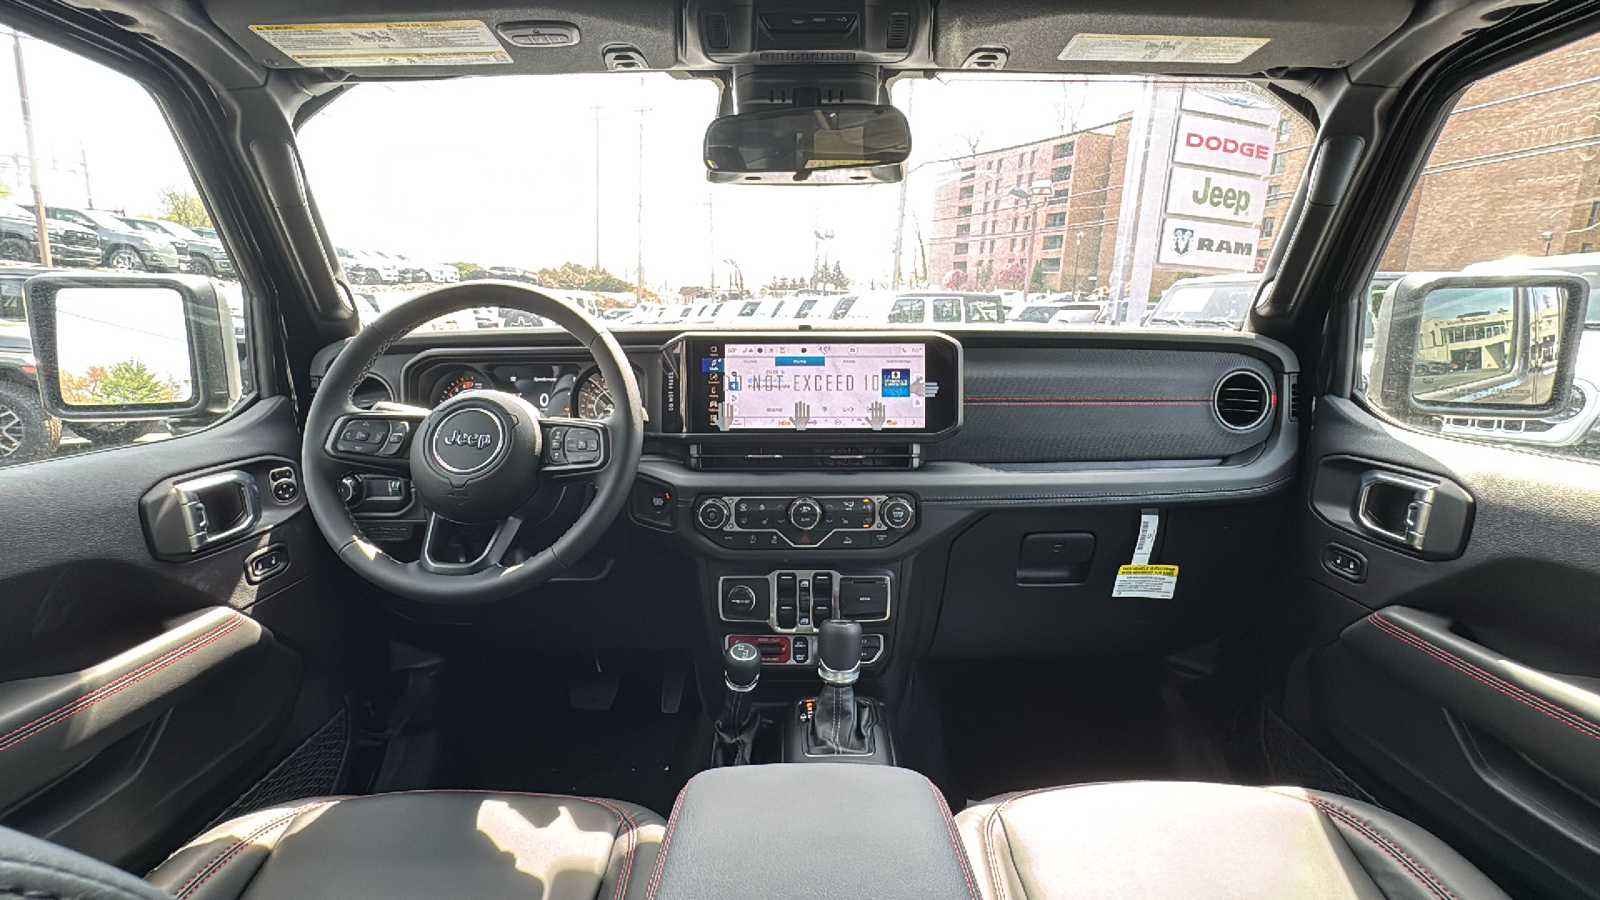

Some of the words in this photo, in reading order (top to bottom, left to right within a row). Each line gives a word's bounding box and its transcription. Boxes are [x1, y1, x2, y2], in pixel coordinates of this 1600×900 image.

[1185, 132, 1270, 160] DODGE
[1192, 177, 1250, 216] Jeep
[1196, 237, 1253, 256] RAM
[753, 375, 783, 391] NOT
[794, 375, 854, 391] EXCEED
[444, 429, 492, 450] Jeep
